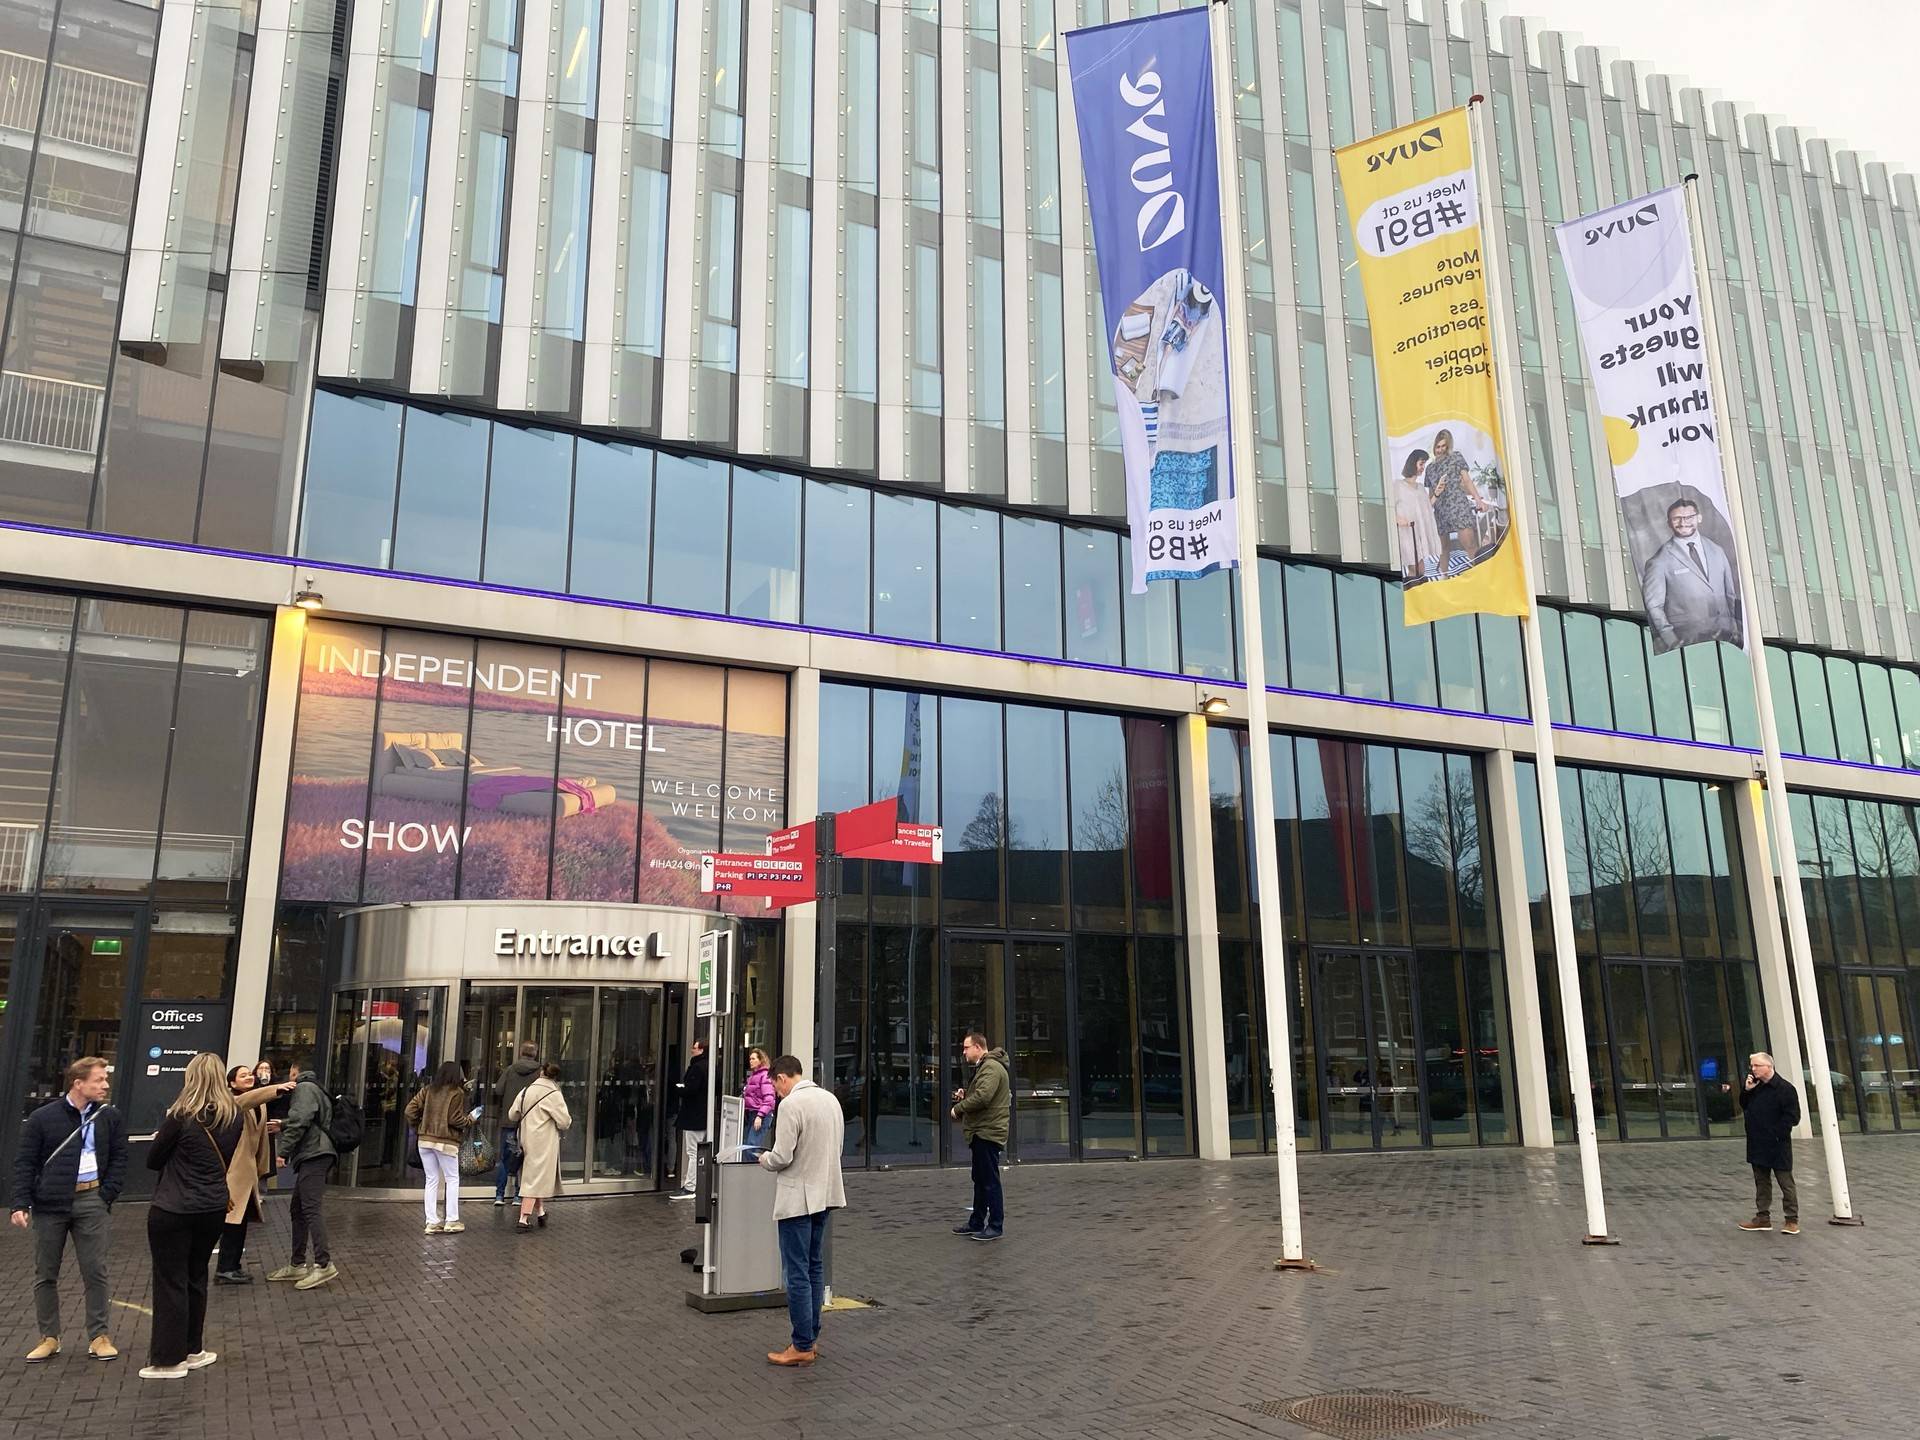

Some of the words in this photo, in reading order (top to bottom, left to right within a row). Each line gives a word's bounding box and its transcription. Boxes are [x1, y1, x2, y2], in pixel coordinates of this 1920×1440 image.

[318, 644, 601, 701] INDEPENDENT
[546, 715, 667, 753] HOTEL
[651, 779, 777, 802] WELCOME
[671, 802, 776, 822] WELKOM
[339, 818, 472, 855] SHOW
[904, 839, 931, 848] Traveller
[650, 859, 683, 870] #IHA24
[715, 858, 753, 867] Entrances
[714, 871, 744, 880] Parking
[494, 928, 645, 957] Entrance
[653, 932, 672, 957] L
[151, 1009, 204, 1022] Offices
